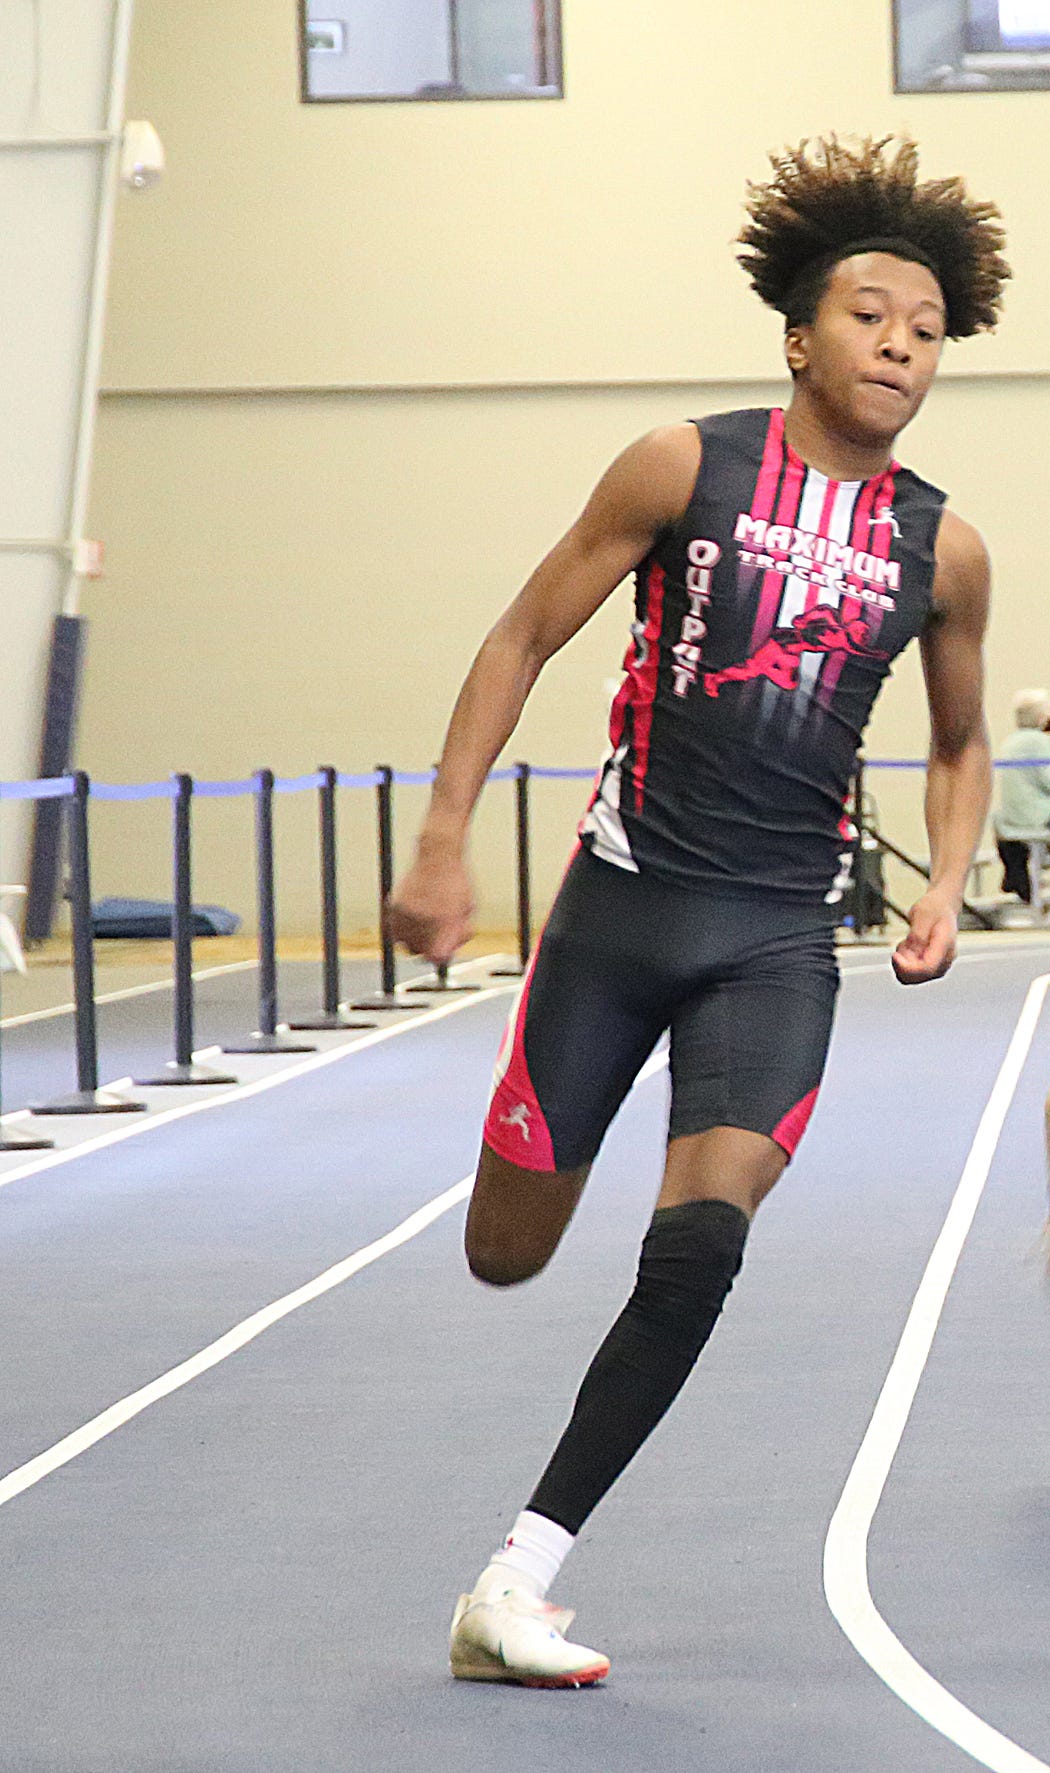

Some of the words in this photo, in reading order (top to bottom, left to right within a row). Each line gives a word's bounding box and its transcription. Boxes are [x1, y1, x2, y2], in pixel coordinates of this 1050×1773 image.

[734, 512, 902, 591] MAXIMUM
[737, 549, 830, 588] TRACK
[834, 578, 897, 612] CLUB
